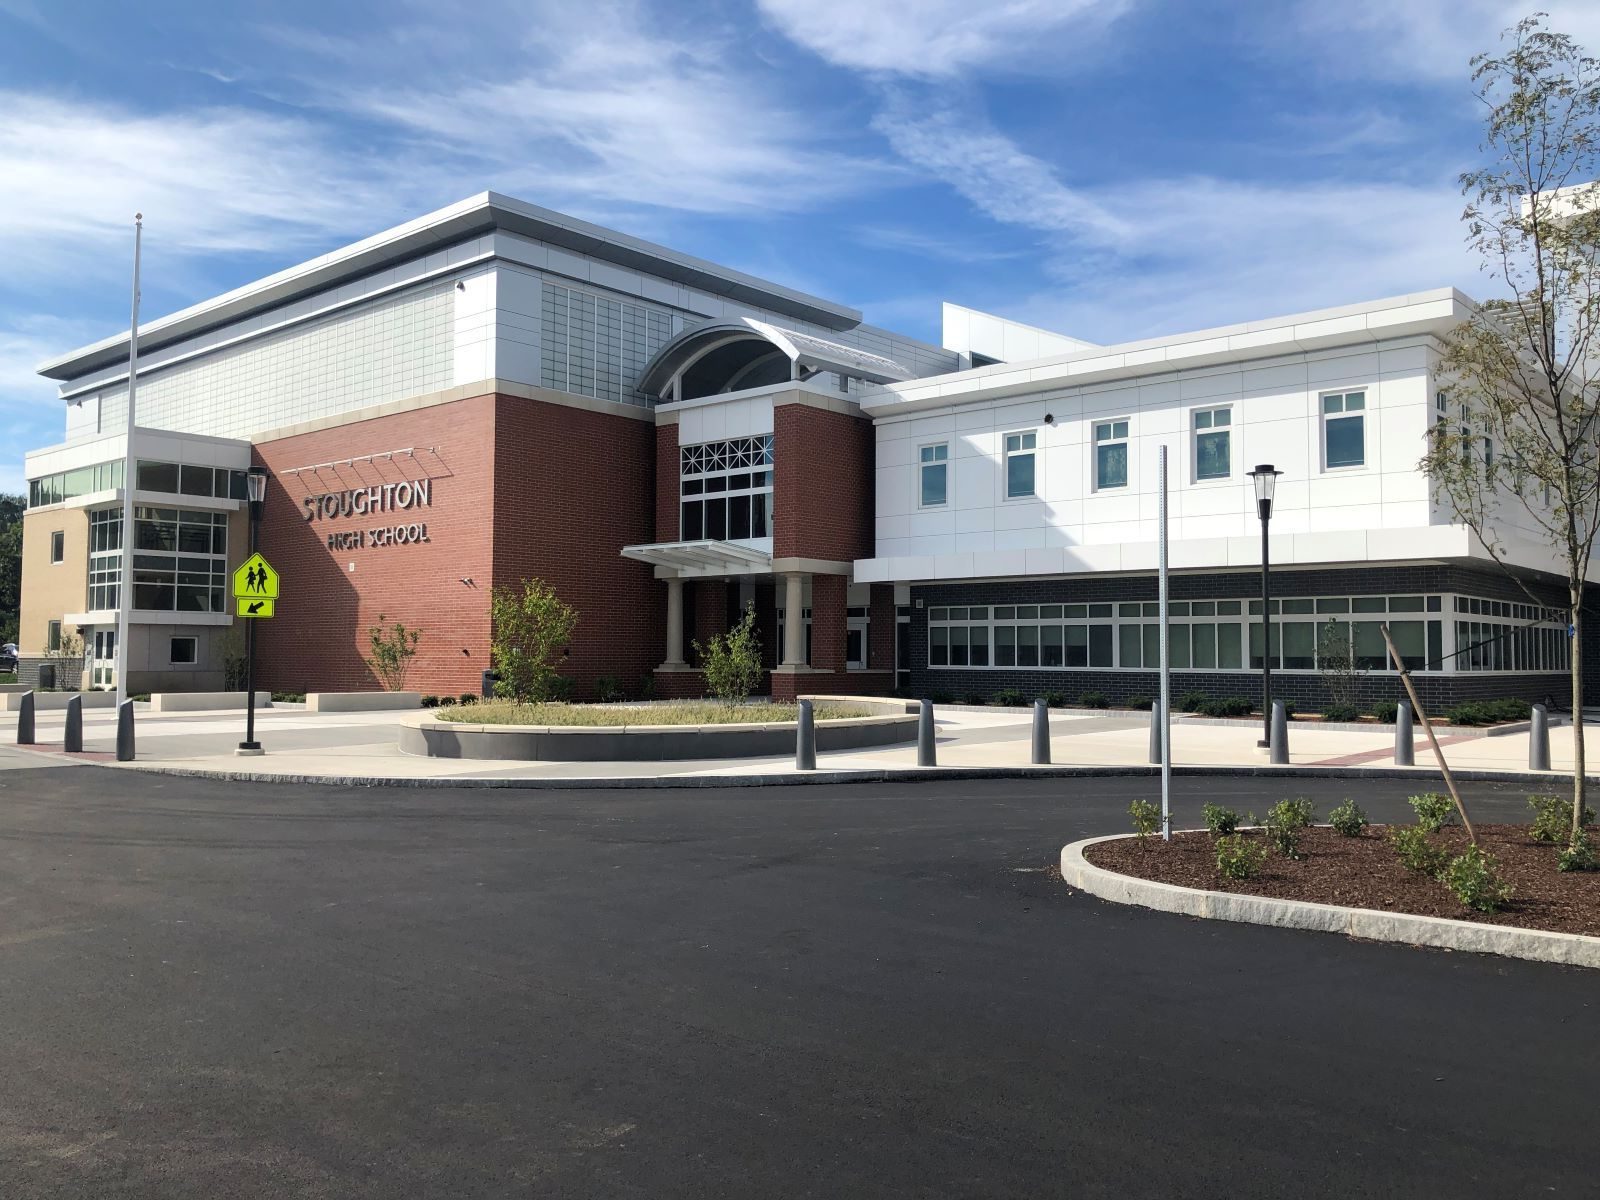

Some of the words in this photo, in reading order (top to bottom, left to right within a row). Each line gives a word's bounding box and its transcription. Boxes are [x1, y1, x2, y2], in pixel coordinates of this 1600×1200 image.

[303, 479, 430, 520] STOUGHTON
[328, 531, 363, 550] HIGH
[368, 523, 429, 547] SCHOOL
